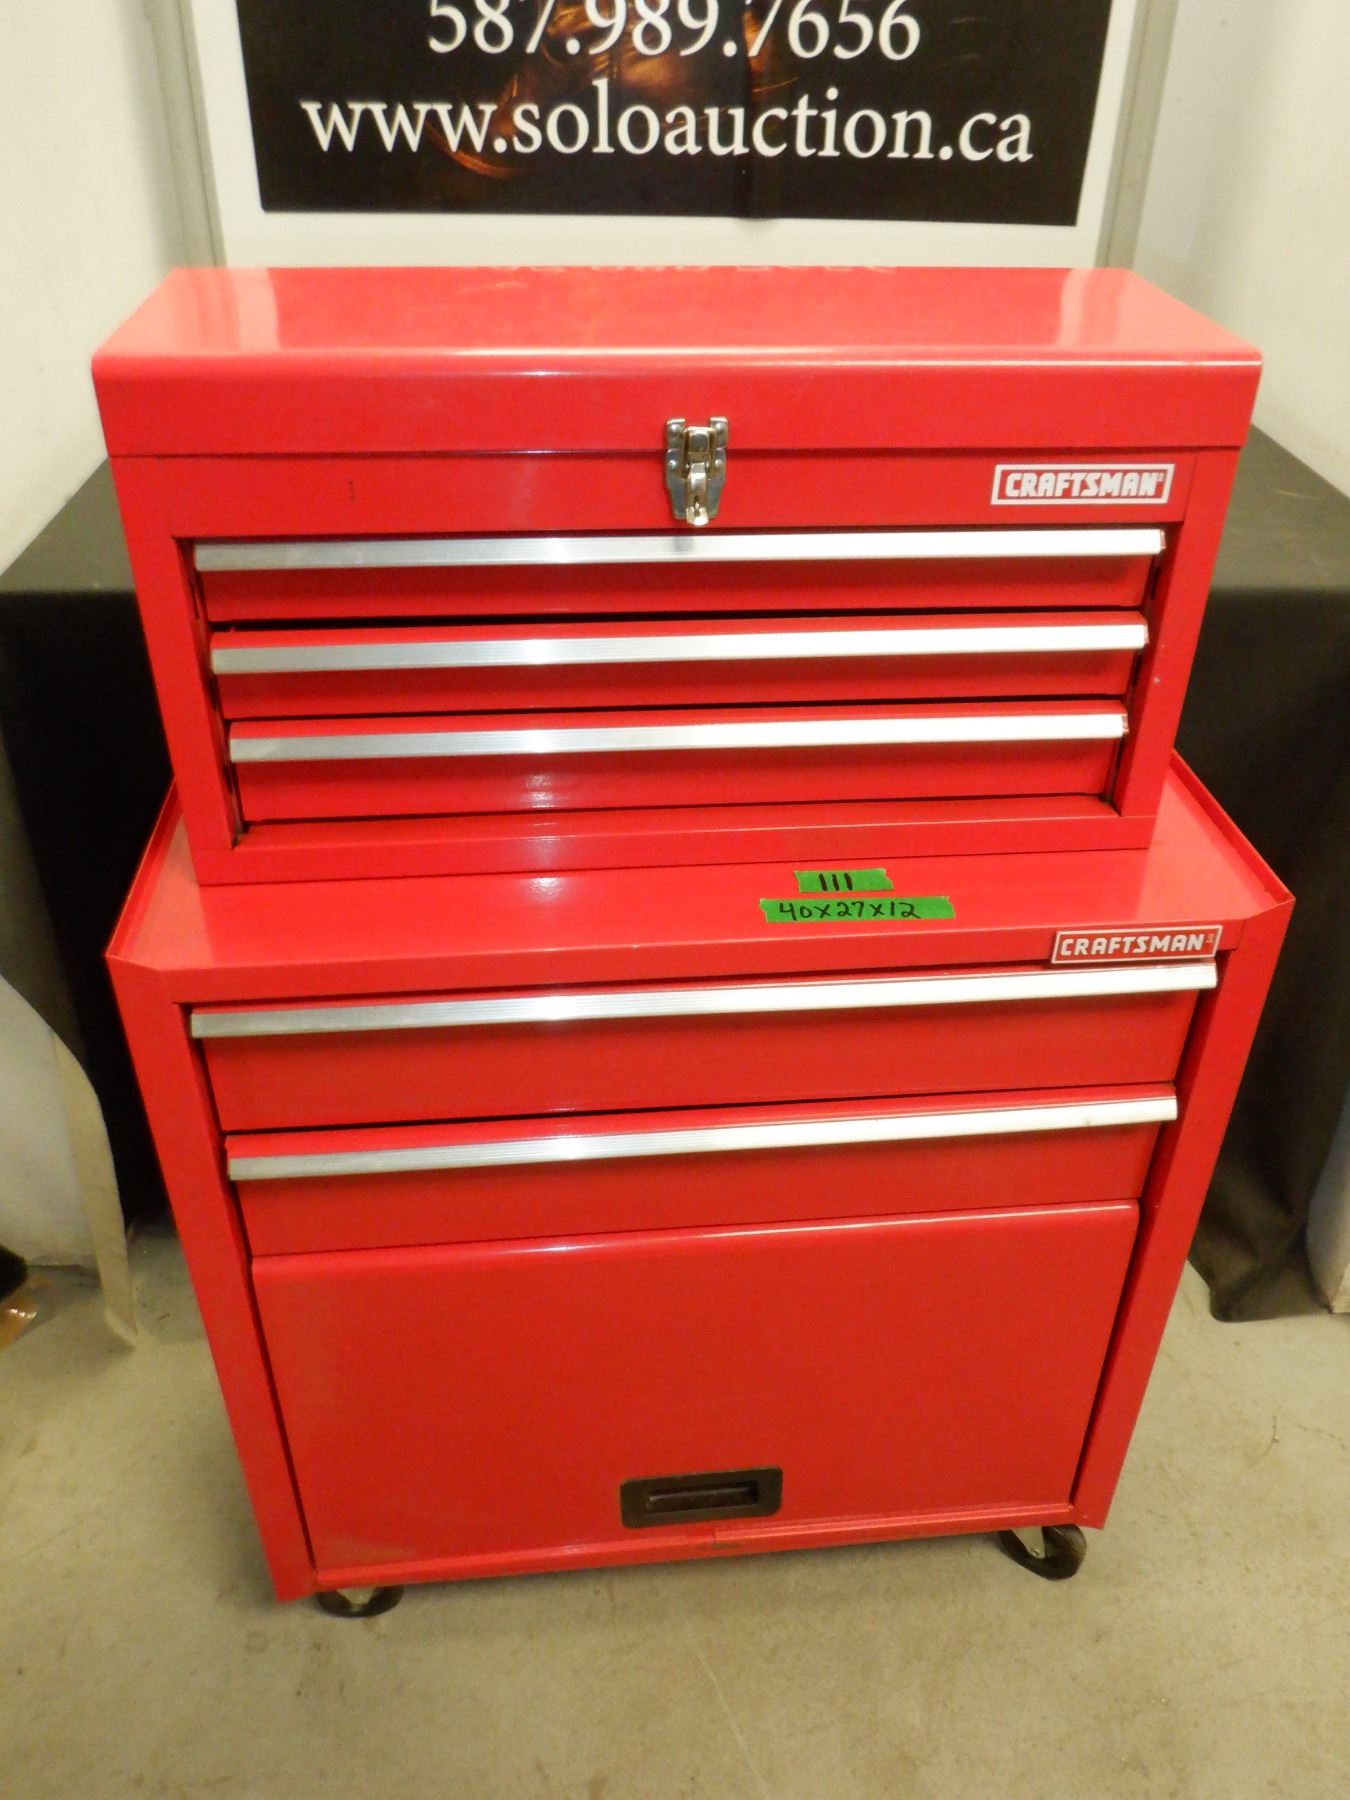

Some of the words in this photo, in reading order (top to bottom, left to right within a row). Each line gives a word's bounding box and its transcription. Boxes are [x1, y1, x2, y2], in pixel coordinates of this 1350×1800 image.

[300, 78, 1034, 163] www.soloauction.ca
[1005, 471, 1160, 498] CRAFTSMAN
[1060, 934, 1204, 957] CRAFTSMAN
